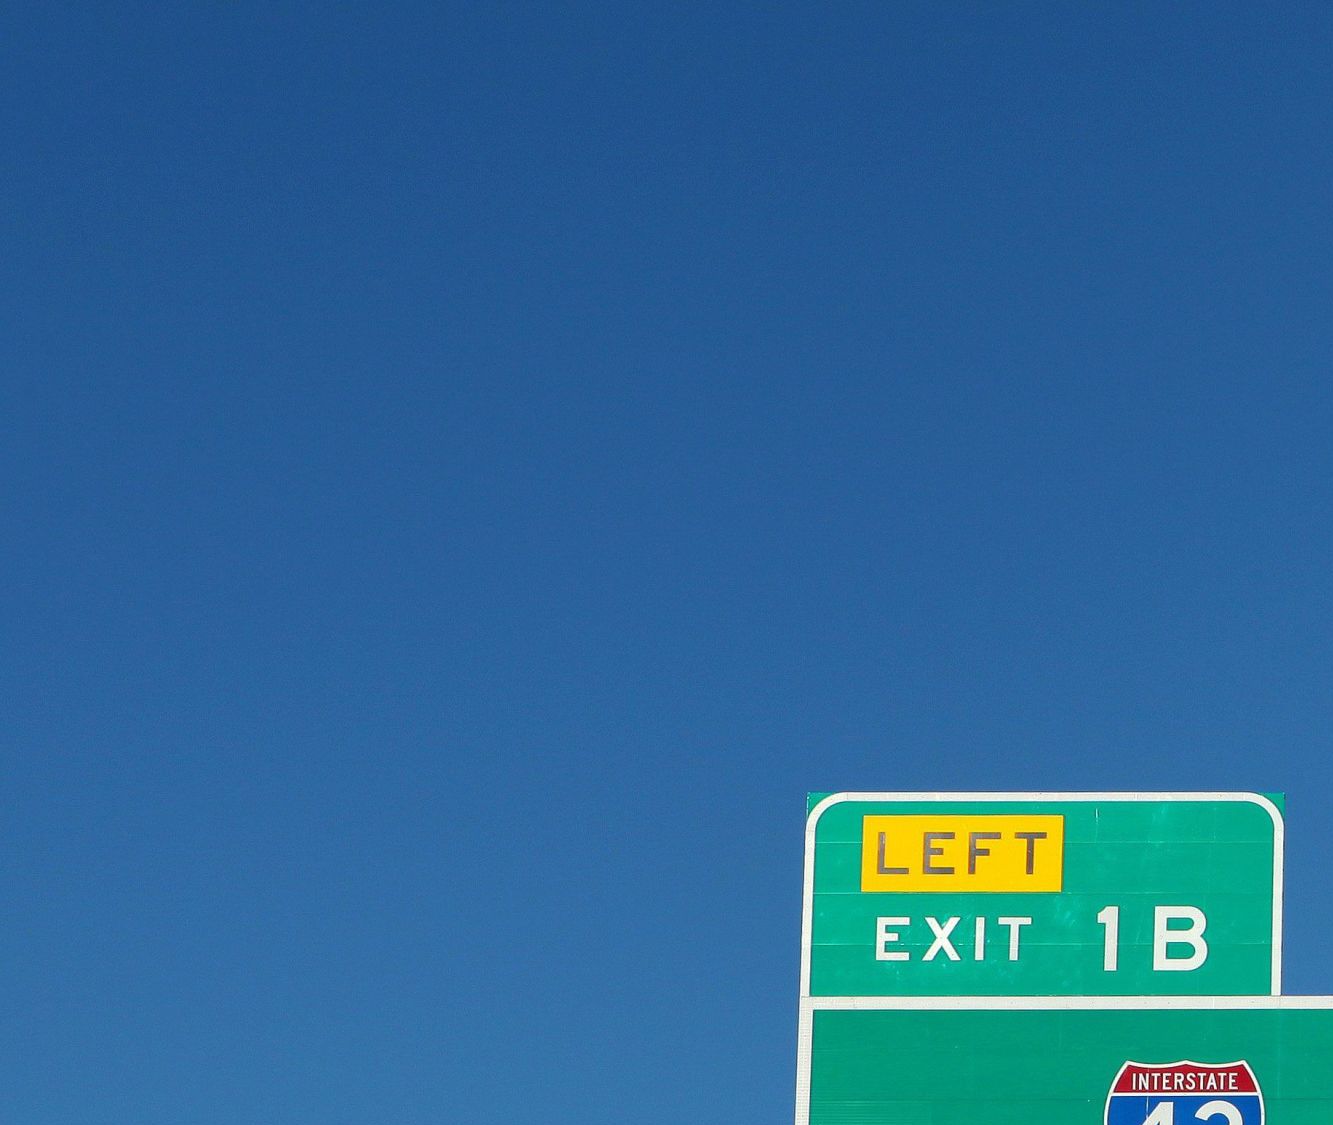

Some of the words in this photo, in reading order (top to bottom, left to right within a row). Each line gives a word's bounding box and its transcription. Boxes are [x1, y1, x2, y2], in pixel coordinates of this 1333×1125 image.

[876, 831, 1048, 876] LEFT
[875, 916, 1032, 961] EXIT
[1097, 905, 1208, 971] 1B
[1131, 1071, 1239, 1092] INTERSTATE
